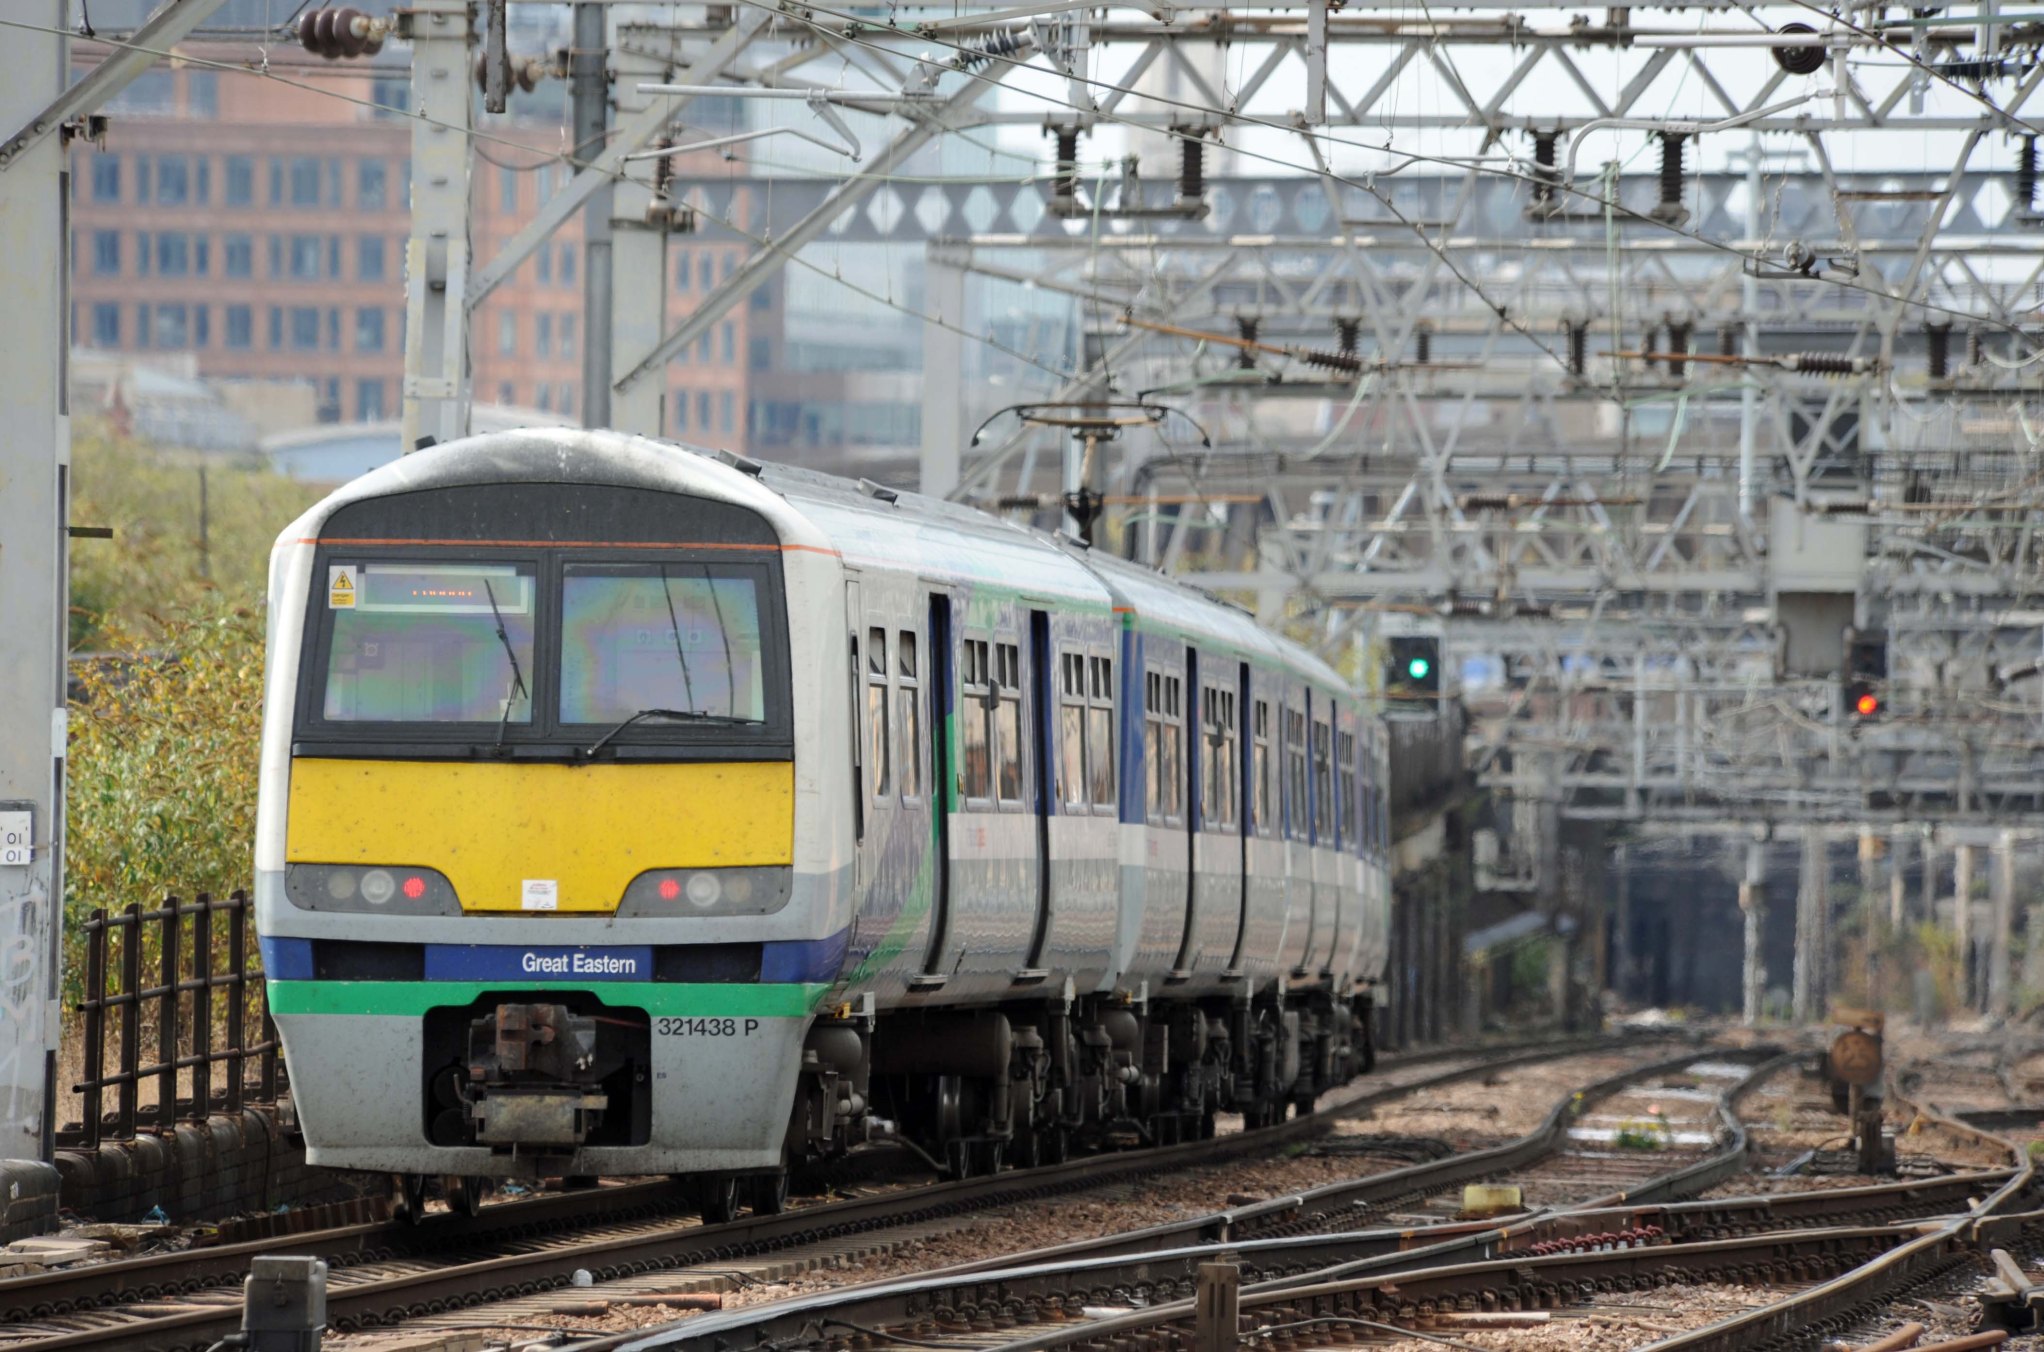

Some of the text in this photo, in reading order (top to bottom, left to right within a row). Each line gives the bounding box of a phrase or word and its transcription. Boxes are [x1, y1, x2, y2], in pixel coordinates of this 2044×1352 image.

[522, 952, 636, 973] Great Eastern
[658, 1018, 759, 1037] 321438 P
